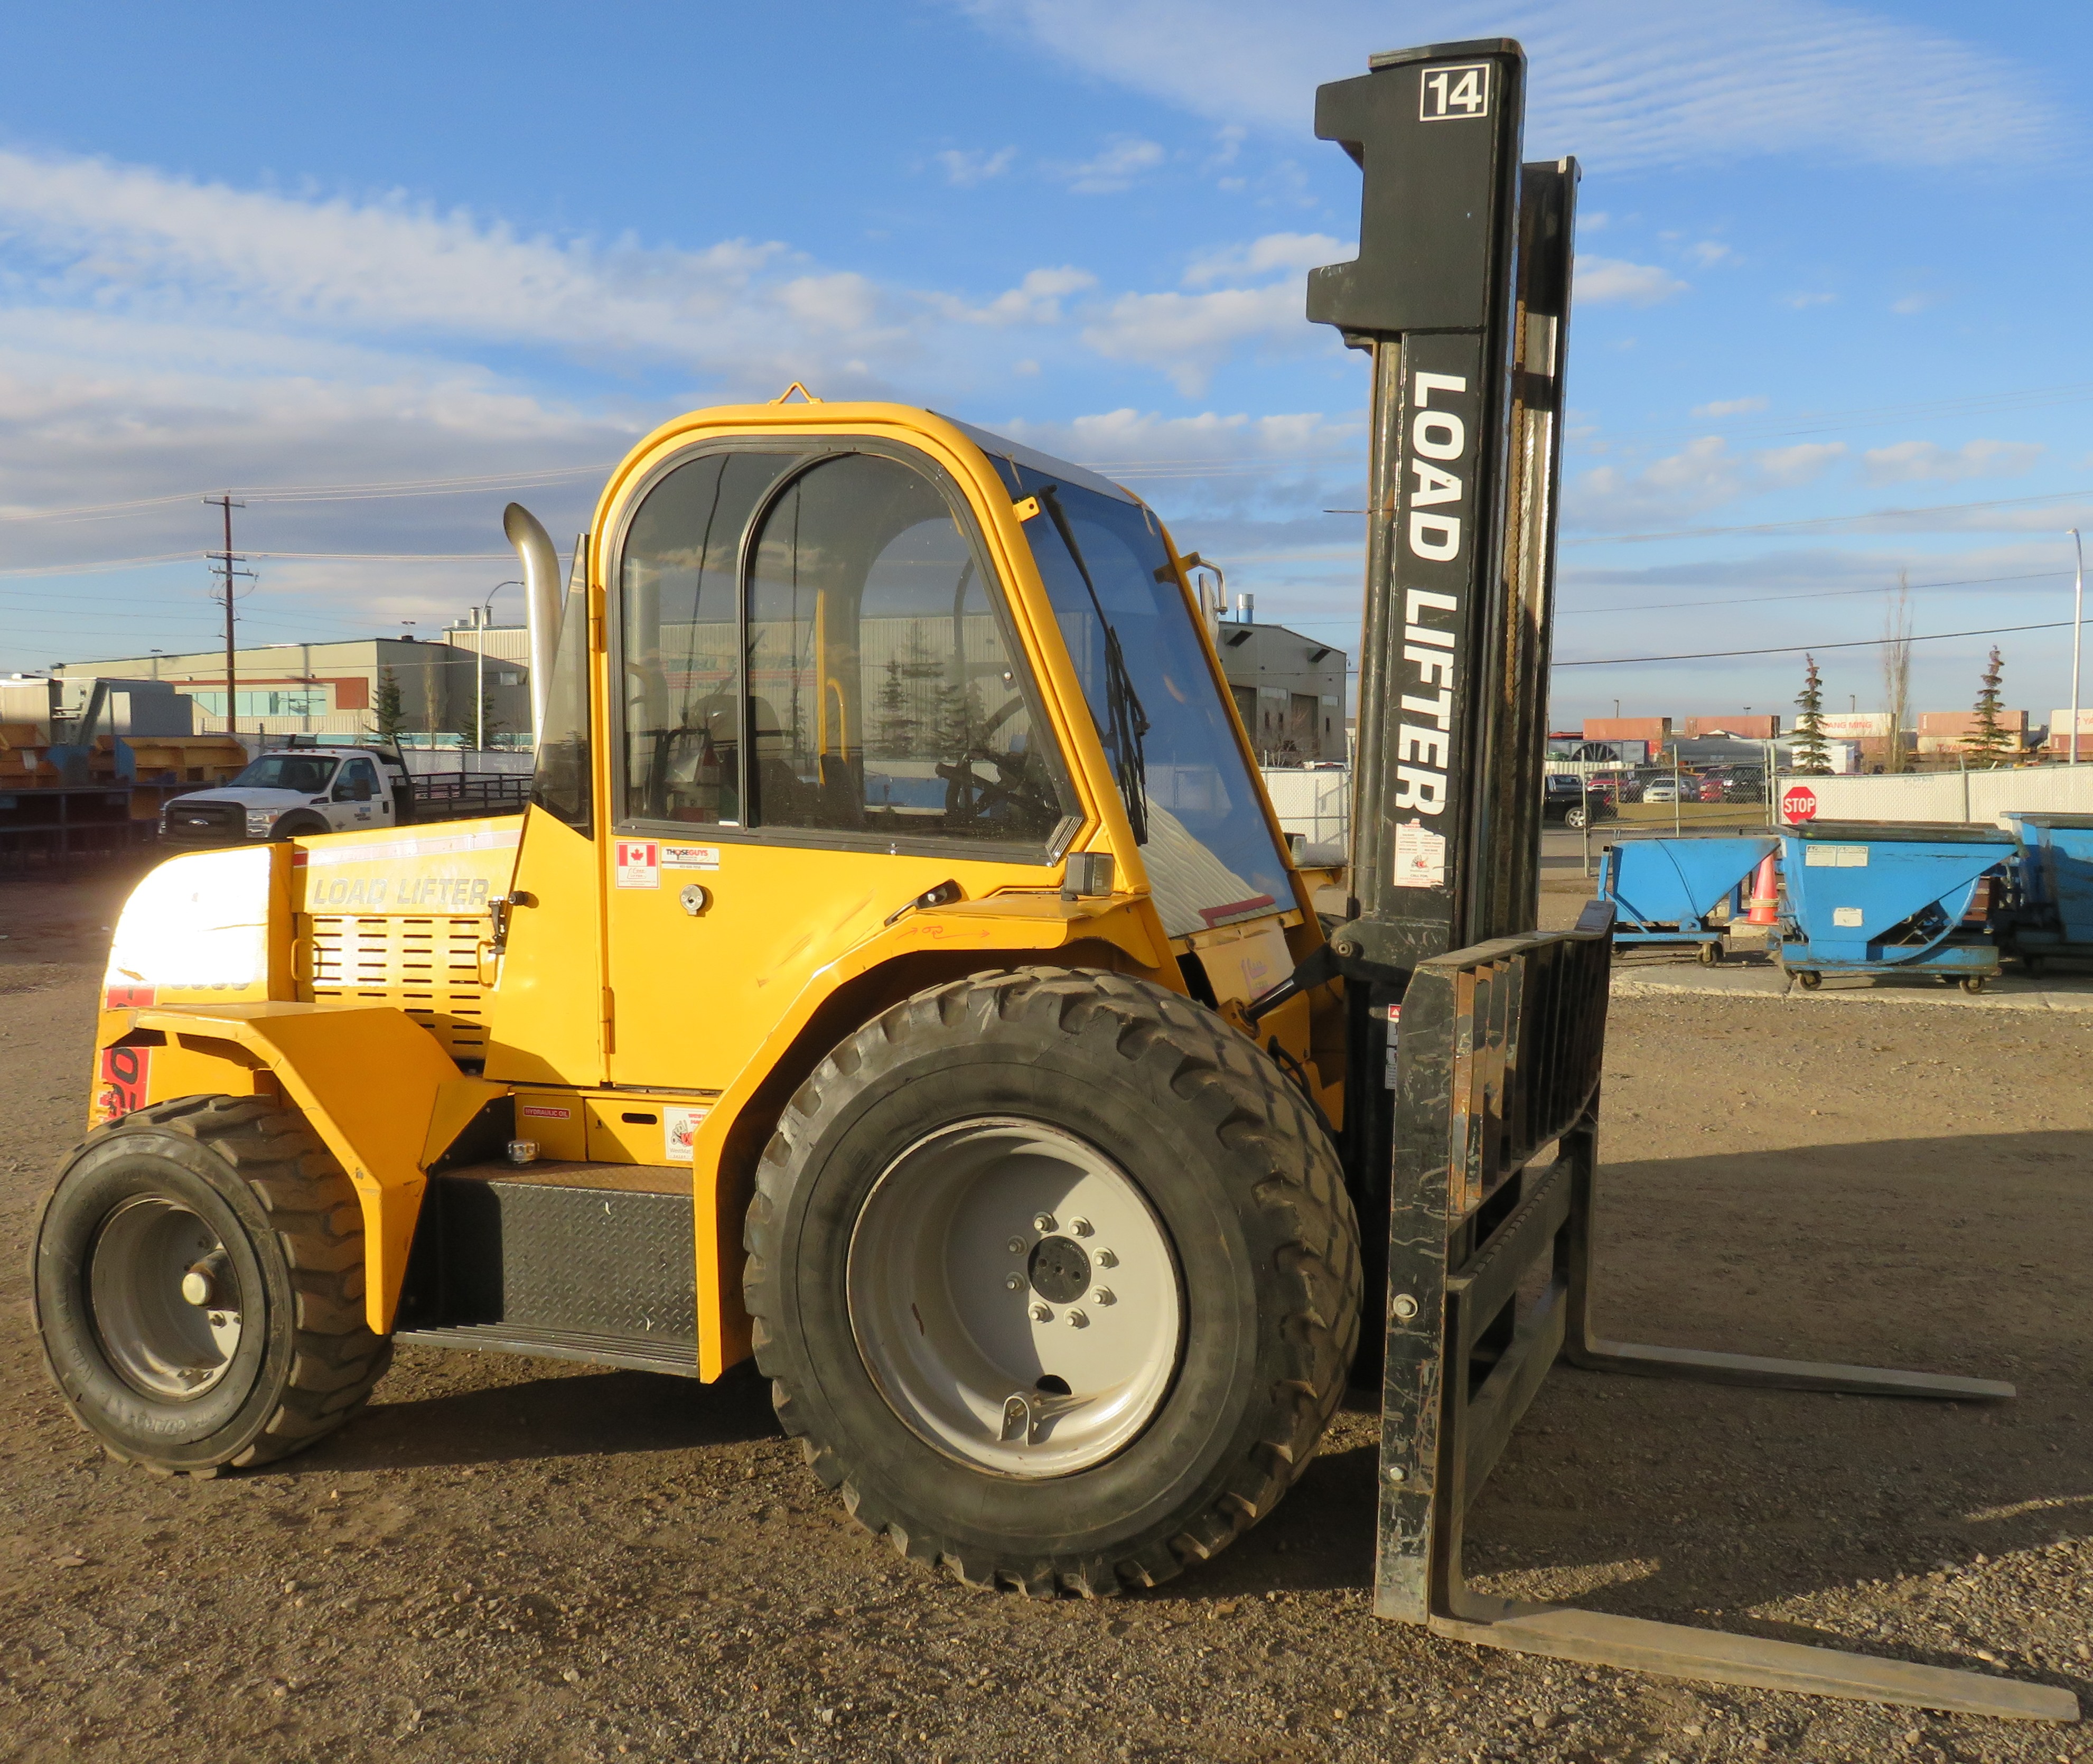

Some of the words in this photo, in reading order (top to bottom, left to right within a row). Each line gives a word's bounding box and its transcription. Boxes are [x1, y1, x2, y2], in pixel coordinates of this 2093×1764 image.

[1428, 70, 1482, 115] 14
[1409, 371, 1466, 562] LOAD
[1395, 589, 1457, 816] LIFTER
[1784, 797, 1815, 814] STOP
[313, 878, 388, 904] LOAD
[396, 878, 489, 906] LIFTER
[525, 1108, 558, 1116] HYDRAULIC
